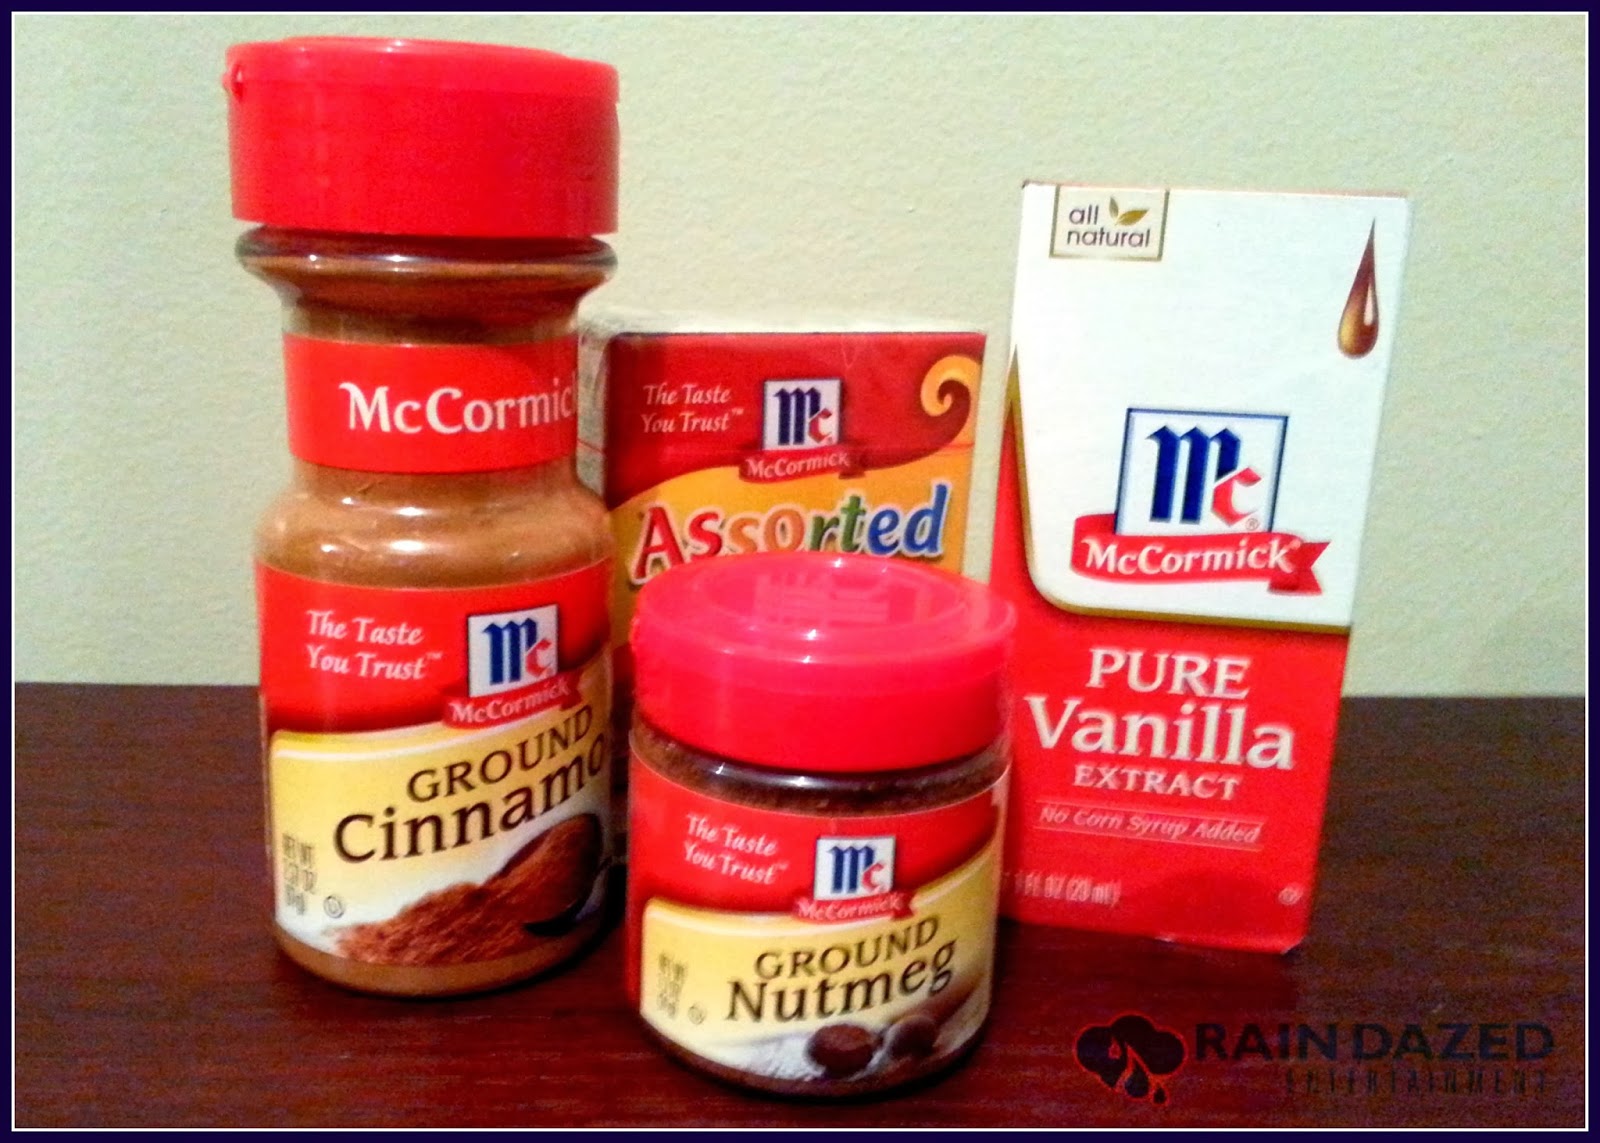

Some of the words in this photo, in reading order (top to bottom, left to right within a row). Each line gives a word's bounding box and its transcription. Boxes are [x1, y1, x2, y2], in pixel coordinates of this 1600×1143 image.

[1069, 203, 1098, 225] all
[1066, 227, 1150, 249] natural
[643, 383, 677, 406] The
[681, 382, 731, 404] Taste
[641, 413, 676, 434] You
[744, 451, 851, 480] McCormick
[630, 481, 953, 586] Assorted
[1080, 535, 1296, 577] McCormick
[305, 609, 347, 640] The
[352, 617, 424, 645] Taste
[307, 644, 349, 675] You
[1086, 647, 1252, 700] PURE
[448, 677, 571, 722] McCormick
[1024, 694, 1295, 771] Vanilla
[406, 704, 593, 803] GROUND
[1072, 763, 1242, 801] EXTRACT
[686, 813, 718, 843] The
[721, 824, 778, 857] Taste
[1039, 805, 1069, 826] No
[1073, 810, 1122, 832] Corn
[1127, 814, 1189, 840] Syrup
[1193, 821, 1262, 845] Added
[684, 840, 717, 871] You
[798, 897, 903, 921] McCormick
[754, 917, 940, 981] GROUND
[726, 939, 957, 1023] Nutmeg
